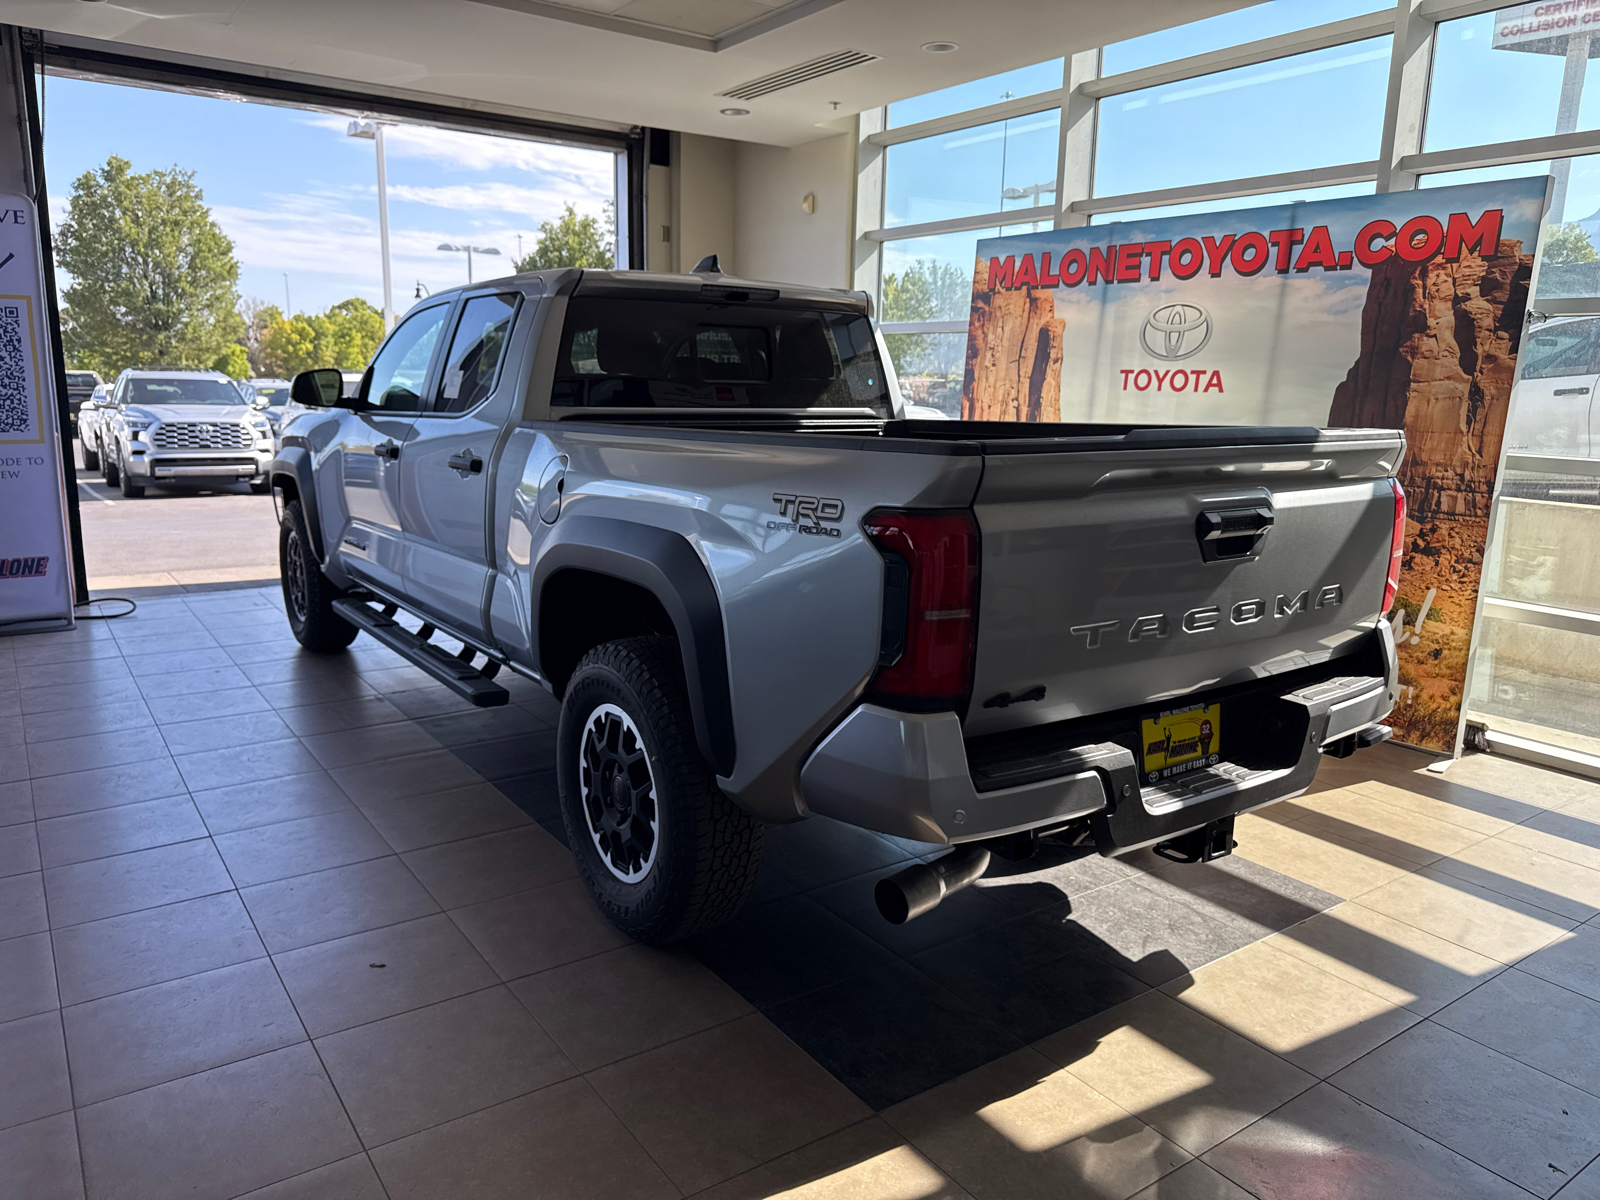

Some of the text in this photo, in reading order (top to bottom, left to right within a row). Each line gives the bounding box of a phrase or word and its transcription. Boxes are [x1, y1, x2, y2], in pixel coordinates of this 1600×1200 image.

[1500, 15, 1577, 37] COLLISION
[987, 208, 1504, 292] MALONETOYOTA.COM
[1119, 369, 1225, 394] TOYOTA
[25, 456, 44, 466] TO
[1, 470, 20, 480] EW
[772, 492, 845, 527] TRD
[766, 520, 842, 539] OFF ROAD
[1069, 583, 1344, 650] TACOMA
[1163, 758, 1206, 777] WE MAKE IT EASY
